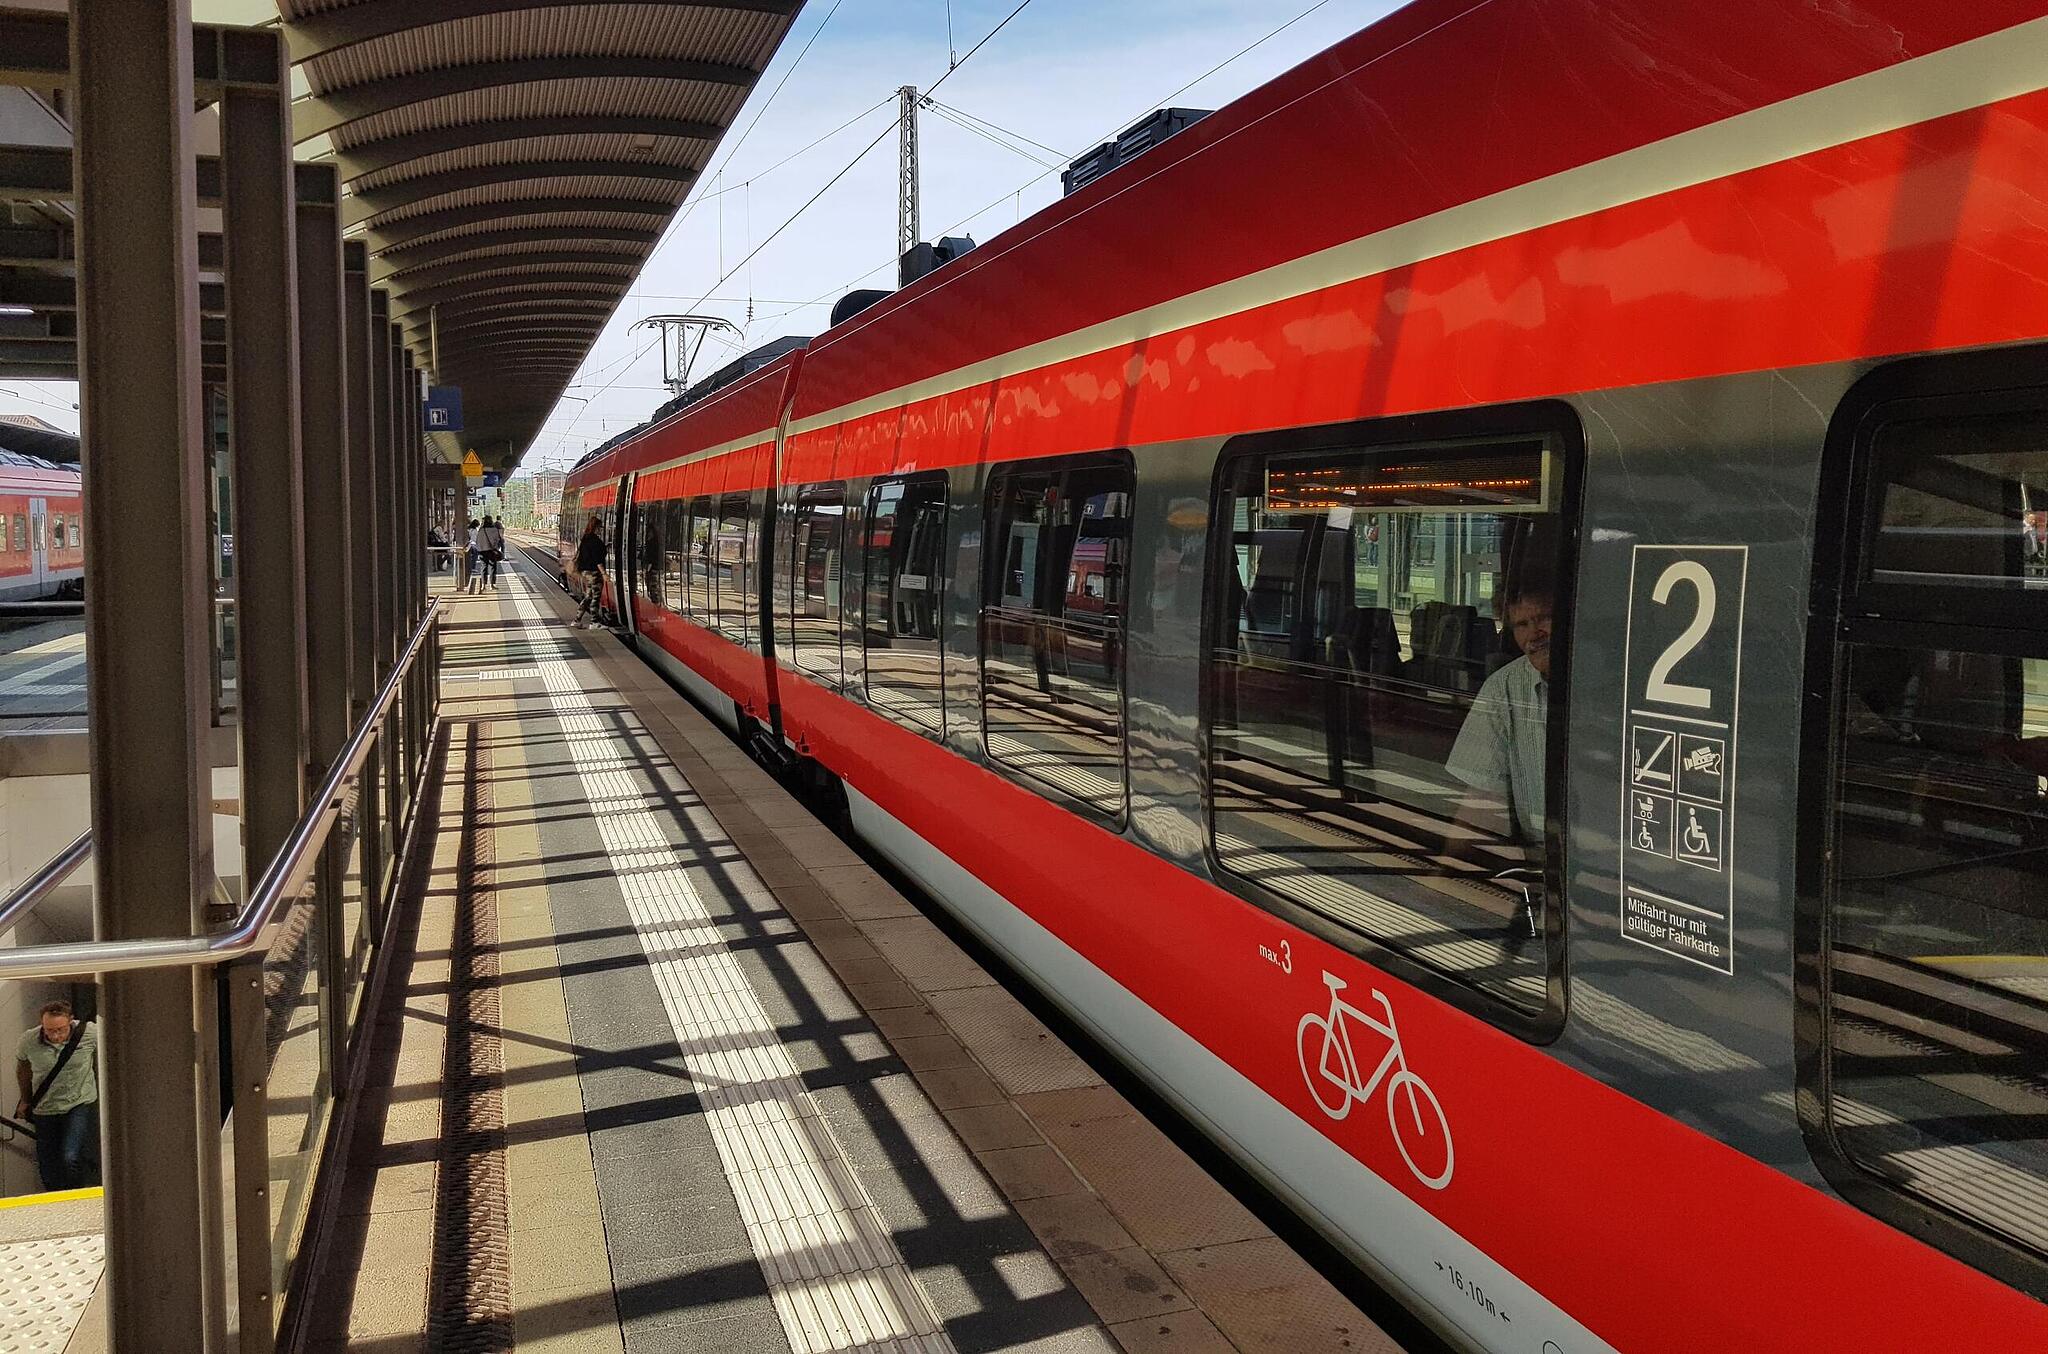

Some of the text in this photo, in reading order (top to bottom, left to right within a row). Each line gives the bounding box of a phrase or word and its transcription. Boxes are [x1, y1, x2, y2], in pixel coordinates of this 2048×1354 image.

[1646, 561, 1716, 708] 2
[1628, 897, 1707, 936] Mitfahrt nur mit
[1628, 915, 1720, 957] gültiger Fahrkarte
